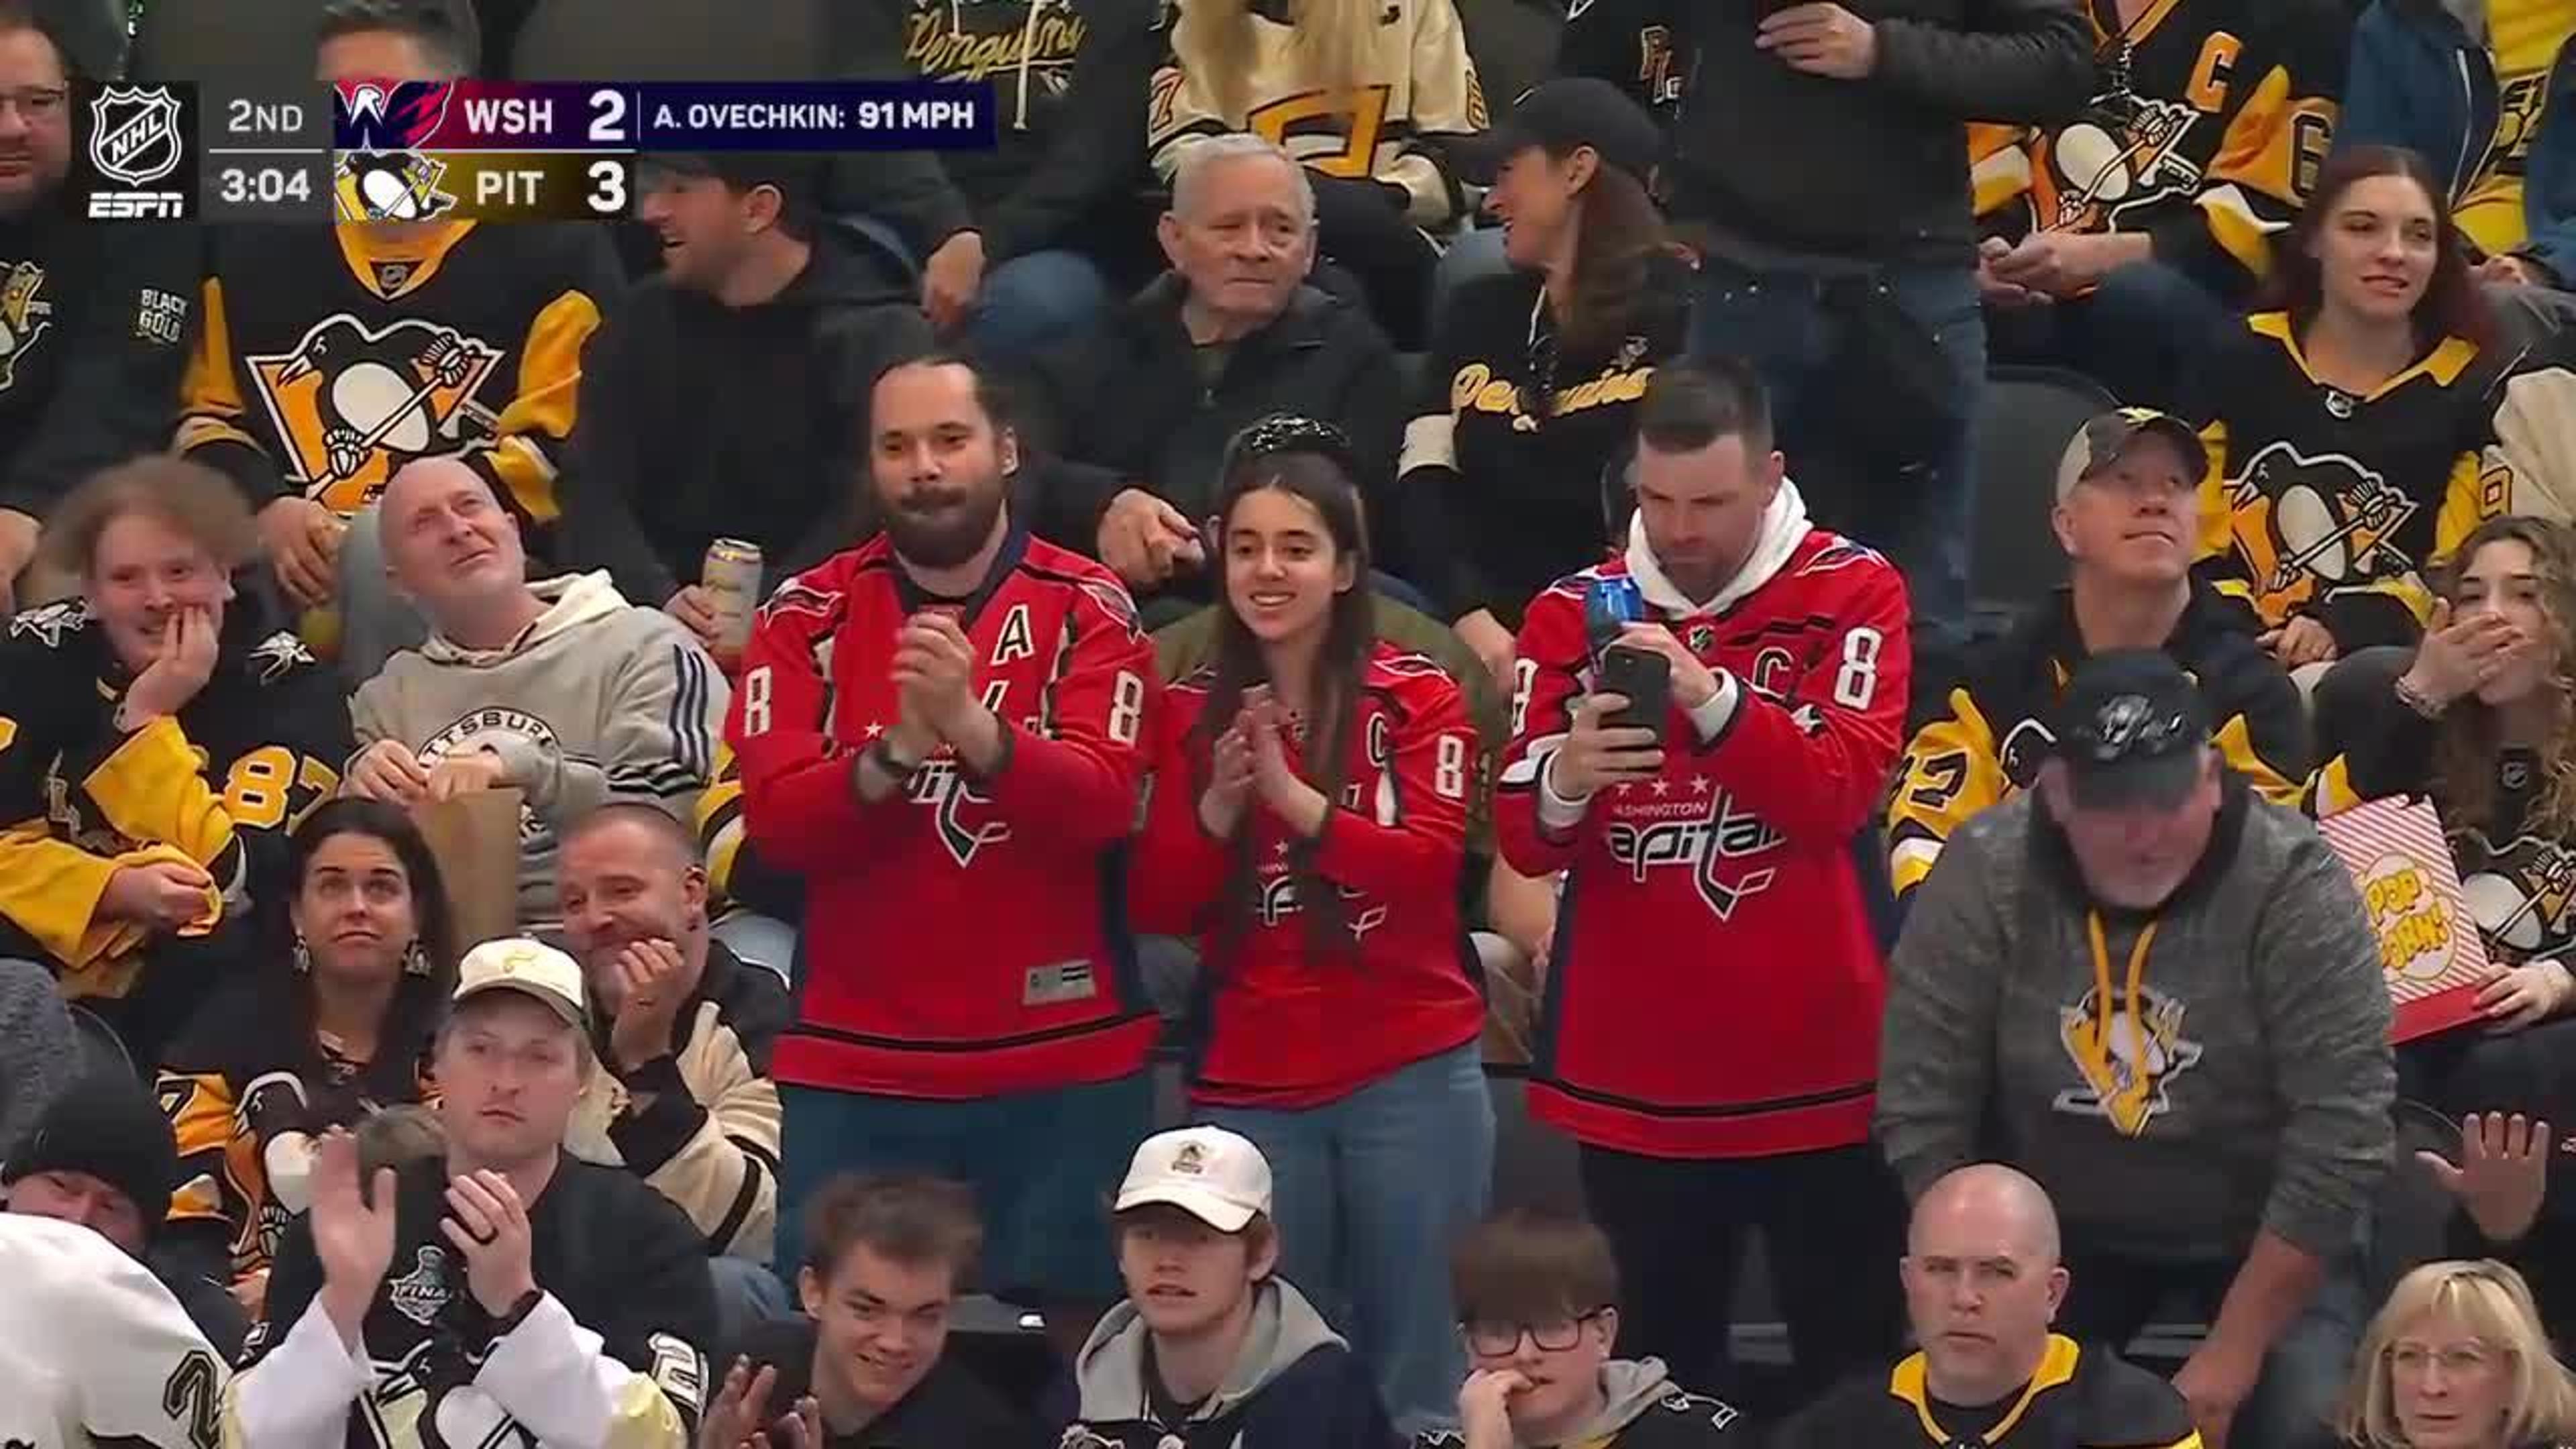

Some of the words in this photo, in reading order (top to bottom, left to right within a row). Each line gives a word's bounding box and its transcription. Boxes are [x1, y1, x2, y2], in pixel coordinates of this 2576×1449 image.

[2186, 30, 2243, 113] C
[989, 603, 1036, 667] A
[1834, 626, 1884, 711] 8
[743, 665, 772, 738] 8
[1752, 646, 1794, 700] C
[417, 710, 554, 770] ITTSBUR
[1108, 669, 1145, 749] 8
[224, 745, 341, 837] 87
[1434, 733, 1465, 798] 8
[1611, 800, 1709, 818] ASHINGTON
[1607, 785, 1788, 922] apital
[398, 1284, 447, 1299] FINA
